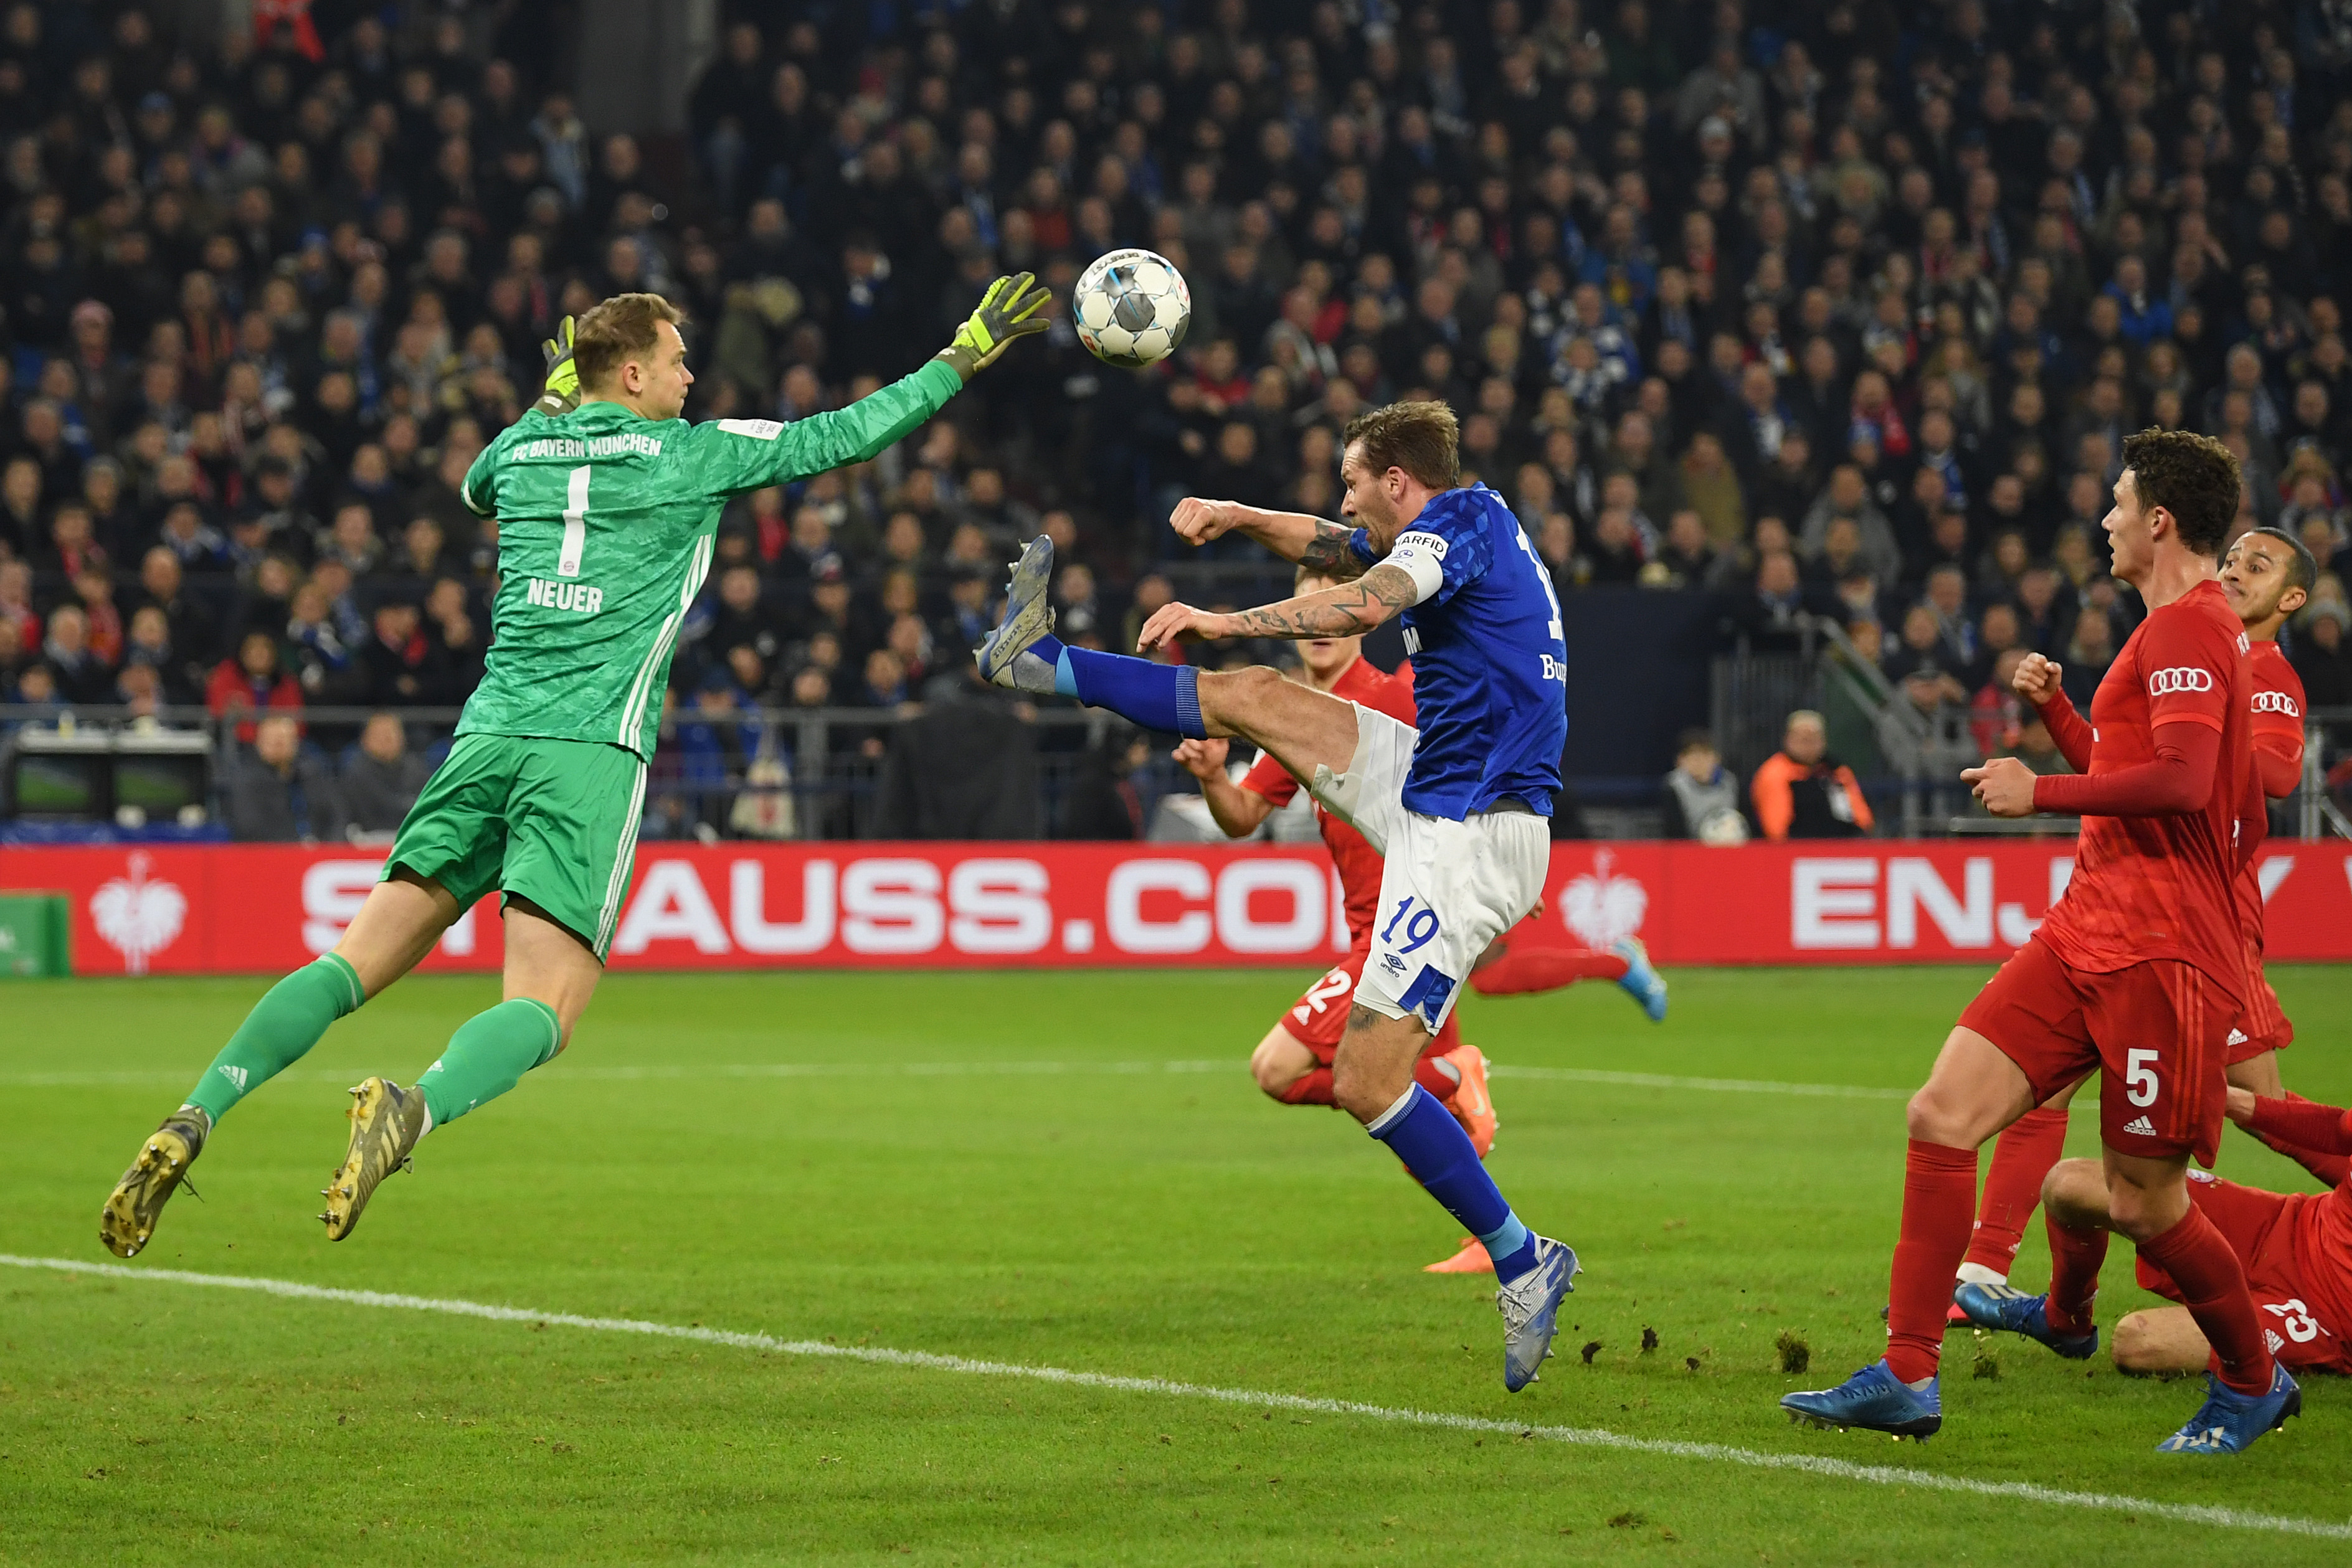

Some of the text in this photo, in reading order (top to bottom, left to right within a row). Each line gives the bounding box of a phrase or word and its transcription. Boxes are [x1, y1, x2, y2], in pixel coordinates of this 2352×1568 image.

[1081, 252, 1140, 289] DERBYSTR
[511, 444, 529, 462] FC
[529, 438, 586, 458] BAYERN
[557, 464, 591, 577] 1
[527, 577, 603, 613] NEUER
[301, 858, 1351, 955] SAUSS.CO
[1380, 895, 1439, 955] 19
[1791, 856, 2295, 949] ENJ
[1304, 966, 1352, 1014] 2
[1380, 961, 1400, 978] umbro
[2126, 1048, 2159, 1108] 5
[2123, 1125, 2156, 1136] adidas
